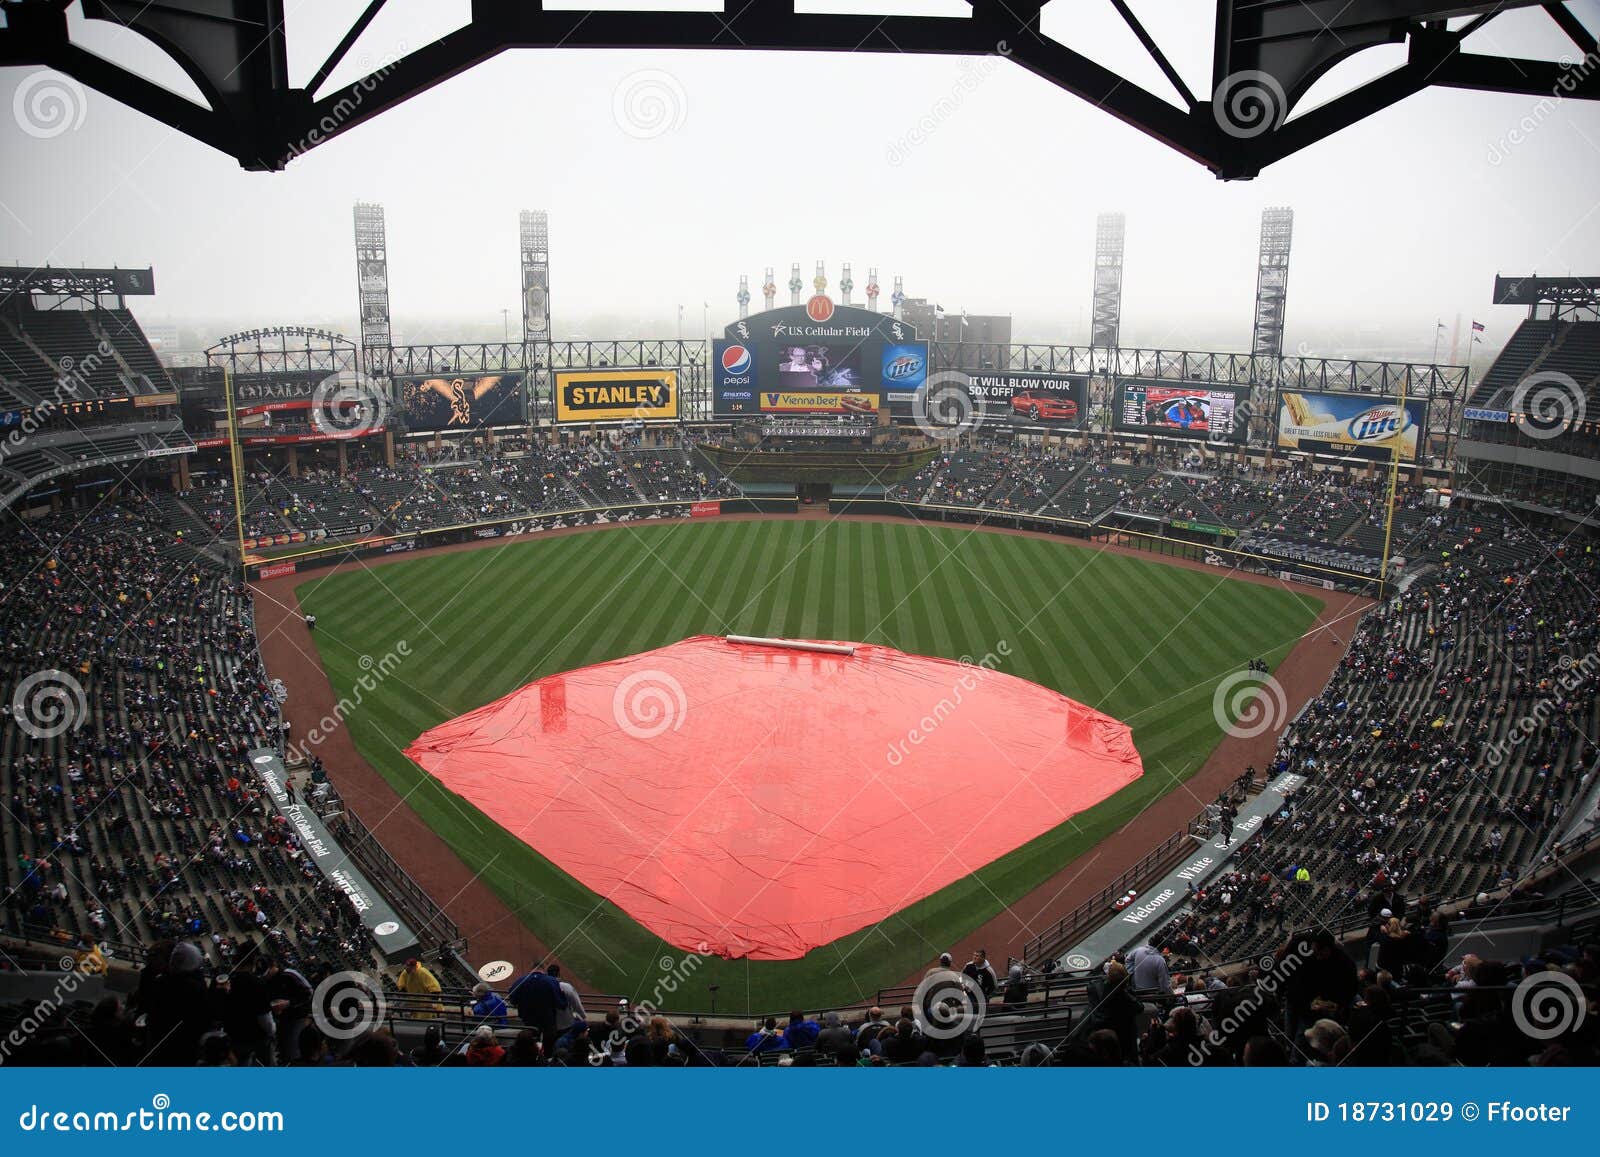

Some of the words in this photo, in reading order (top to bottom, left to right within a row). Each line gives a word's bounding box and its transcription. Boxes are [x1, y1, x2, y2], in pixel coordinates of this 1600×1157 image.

[219, 326, 344, 349] FUNDAMENTALS
[805, 327, 844, 336] Cellular
[846, 327, 870, 336] Field
[724, 375, 750, 384] pepsi
[969, 377, 980, 386] IT
[981, 377, 1006, 387] WILL
[1009, 379, 1040, 388] BLOW
[1042, 380, 1070, 390] YOUR
[572, 386, 662, 404] STANLEY
[969, 386, 989, 396] SOX
[992, 387, 1014, 397] OFF!
[782, 395, 815, 405] Vienna
[817, 396, 838, 406] Beef
[1357, 416, 1401, 440] Lite
[1123, 887, 1175, 924] Welcome
[1177, 856, 1214, 881] White
[1237, 814, 1262, 832] Fans
[331, 870, 356, 894] WHITE
